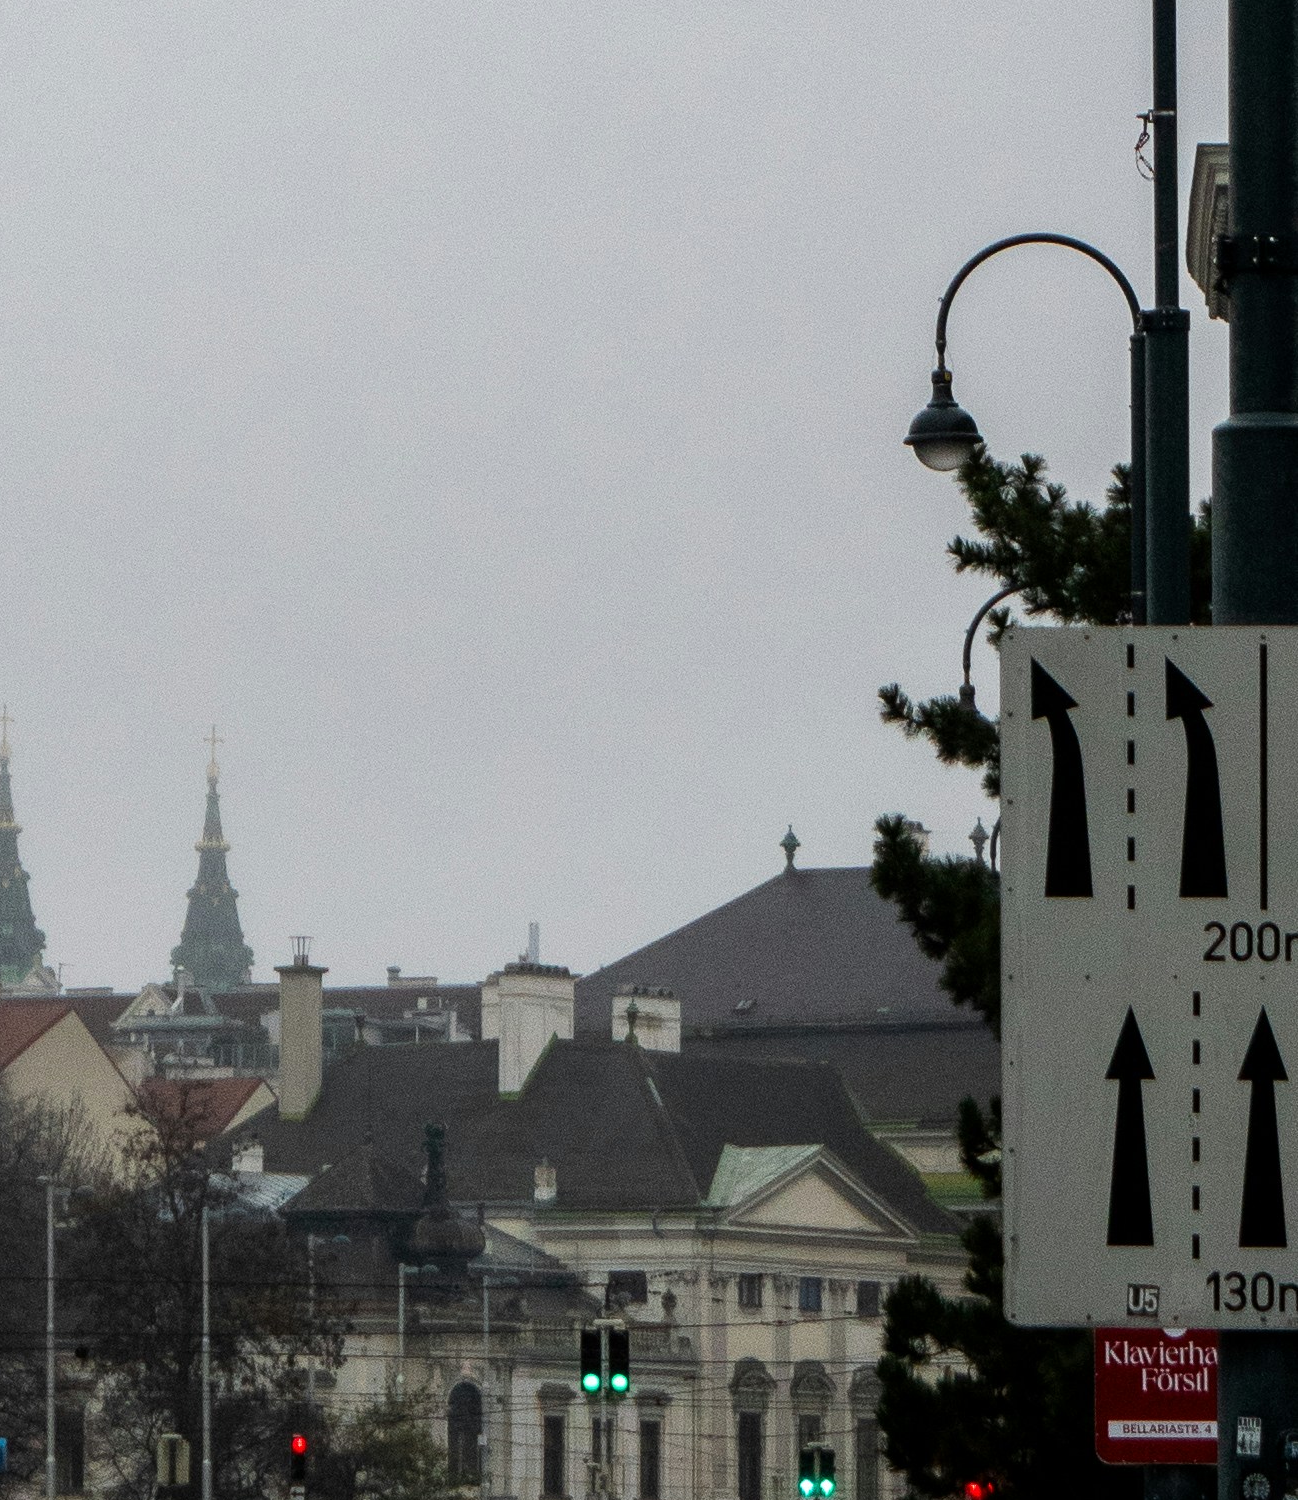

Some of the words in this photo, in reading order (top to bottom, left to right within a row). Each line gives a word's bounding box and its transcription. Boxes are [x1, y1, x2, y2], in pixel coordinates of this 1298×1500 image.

[1128, 1285, 1160, 1313] U5
[1141, 1367, 1210, 1392] Förstl
[1122, 1423, 1202, 1435] BELLARIASTR.
[1204, 1424, 1212, 1434] 4
